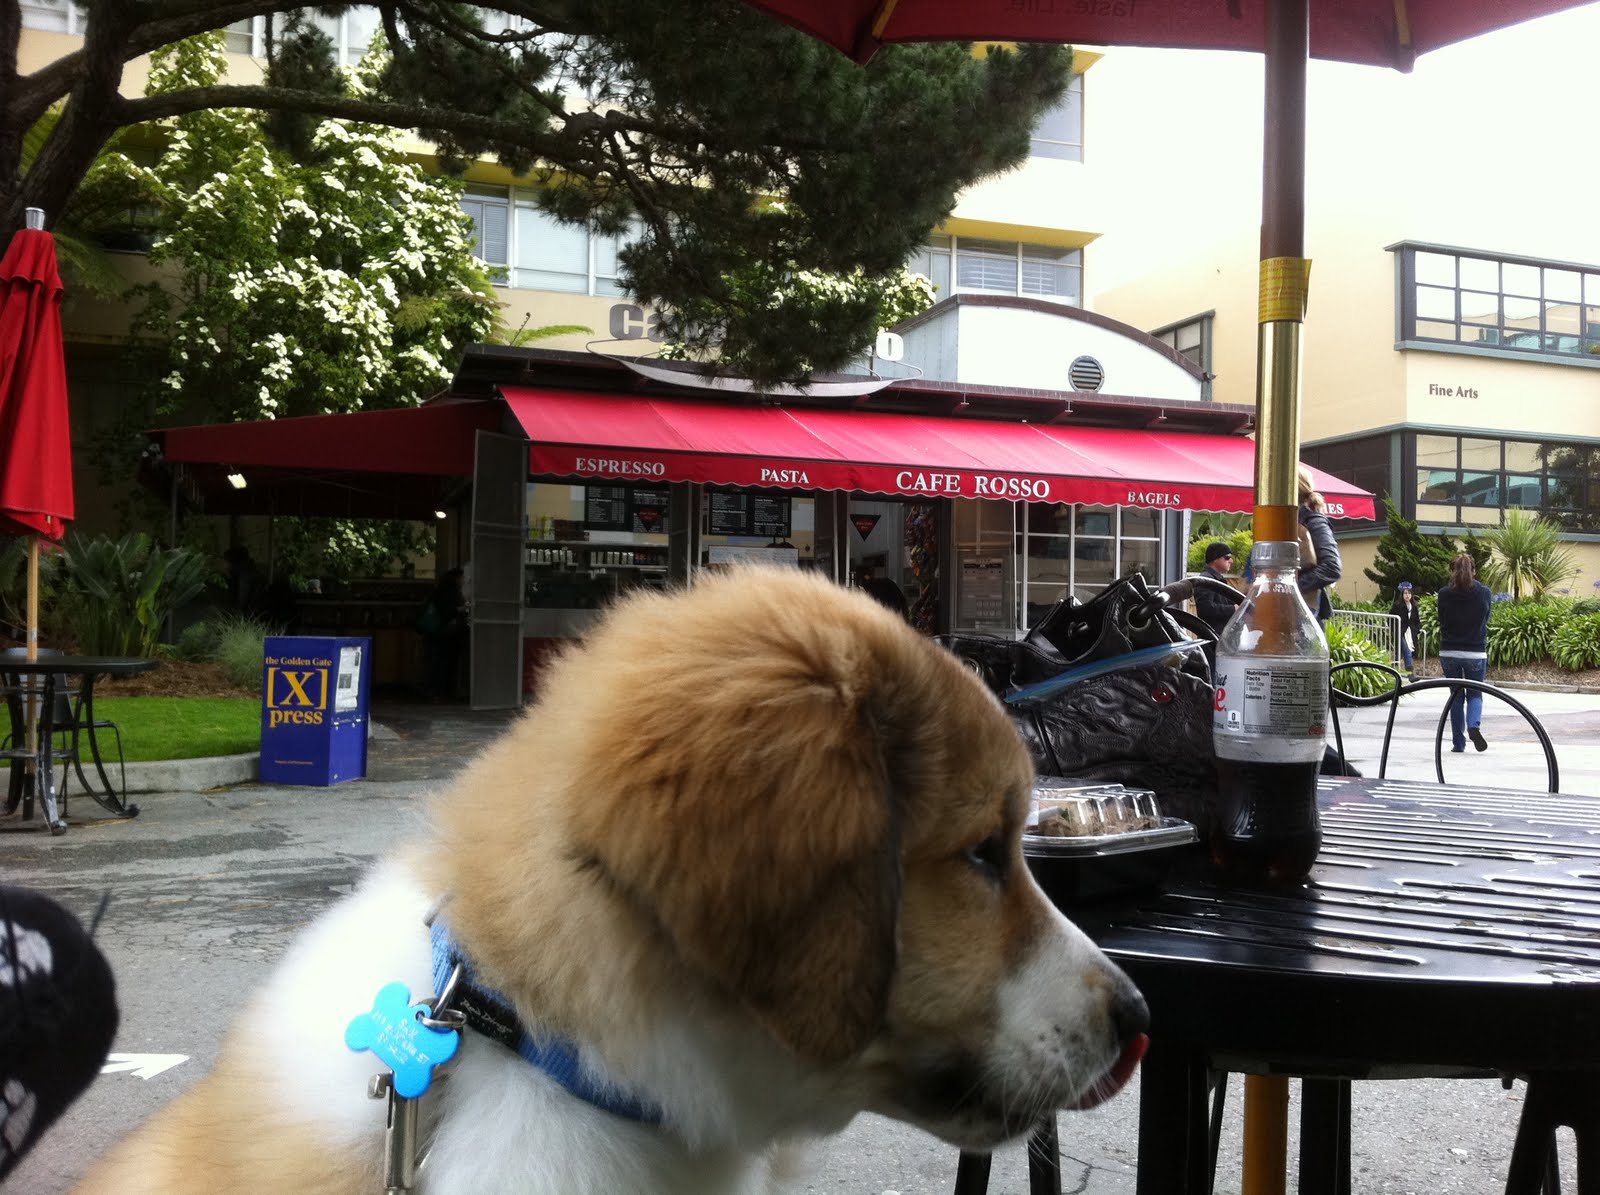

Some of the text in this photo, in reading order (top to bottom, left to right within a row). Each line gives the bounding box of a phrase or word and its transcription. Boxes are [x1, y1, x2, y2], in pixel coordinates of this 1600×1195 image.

[1429, 384, 1478, 399] Fine Arts
[575, 457, 665, 476] ESPRESSO
[760, 468, 809, 484] PASTA
[896, 471, 1050, 498] CAFE ROSSO
[1127, 491, 1180, 506] BAGELS
[265, 656, 332, 667] the Golden Gate
[269, 709, 323, 728] press
